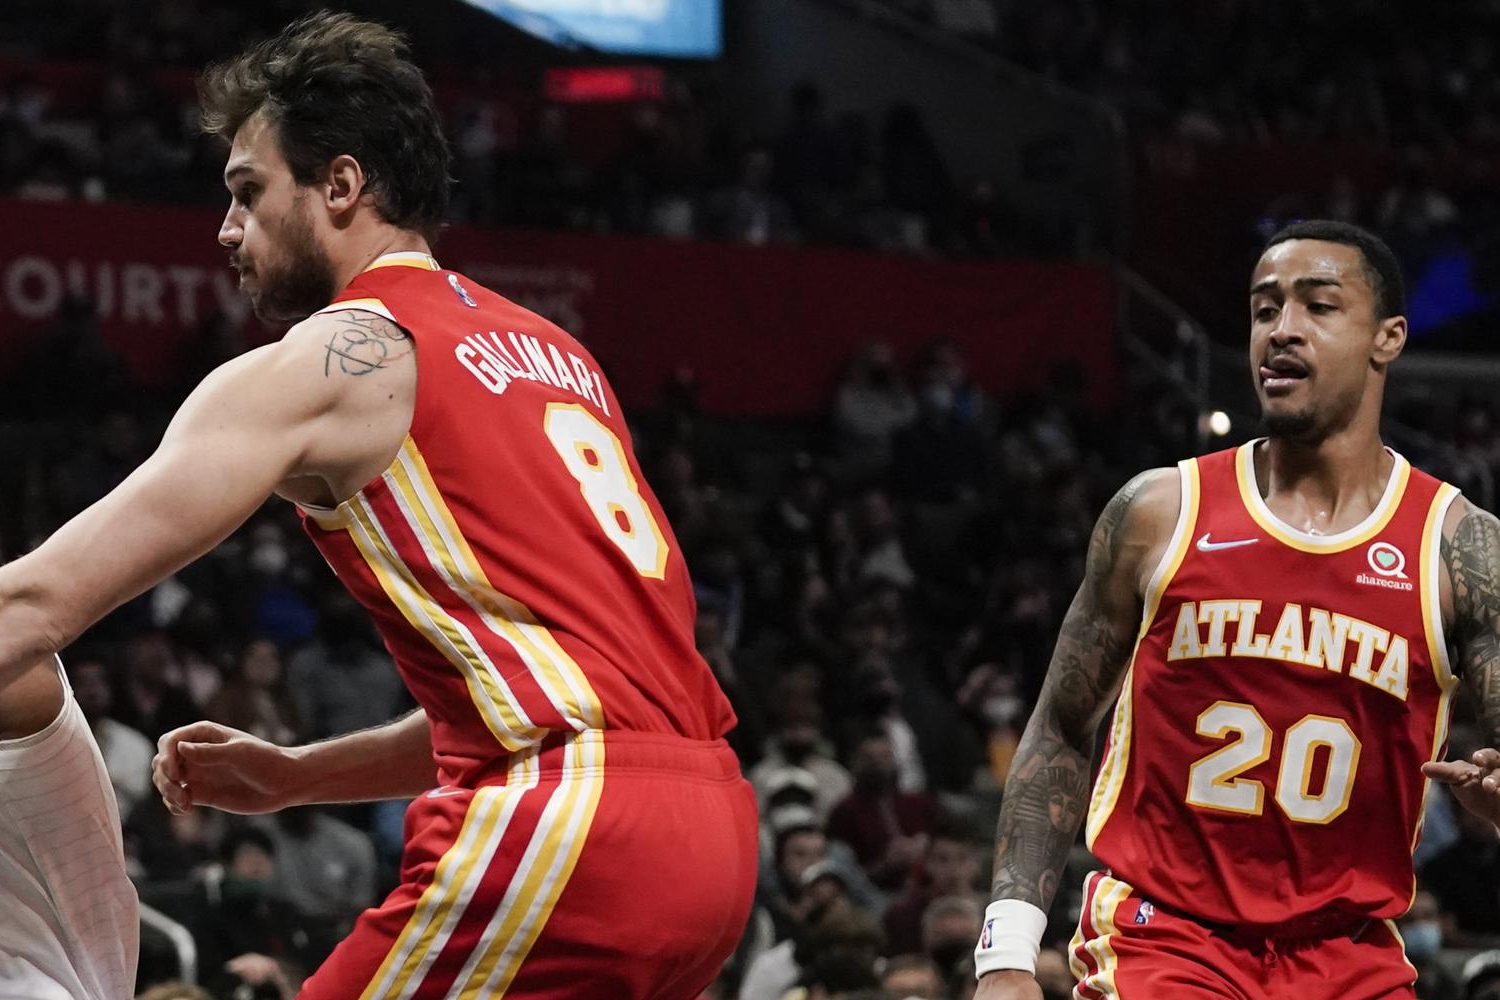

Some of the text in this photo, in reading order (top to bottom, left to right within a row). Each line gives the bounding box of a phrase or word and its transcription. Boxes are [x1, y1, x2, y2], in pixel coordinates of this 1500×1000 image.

[454, 331, 611, 417] GALLINARI
[543, 402, 669, 580] 8
[1355, 573, 1413, 591] sharecare
[1167, 600, 1409, 702] ATLANTA
[1186, 700, 1362, 825] 20
